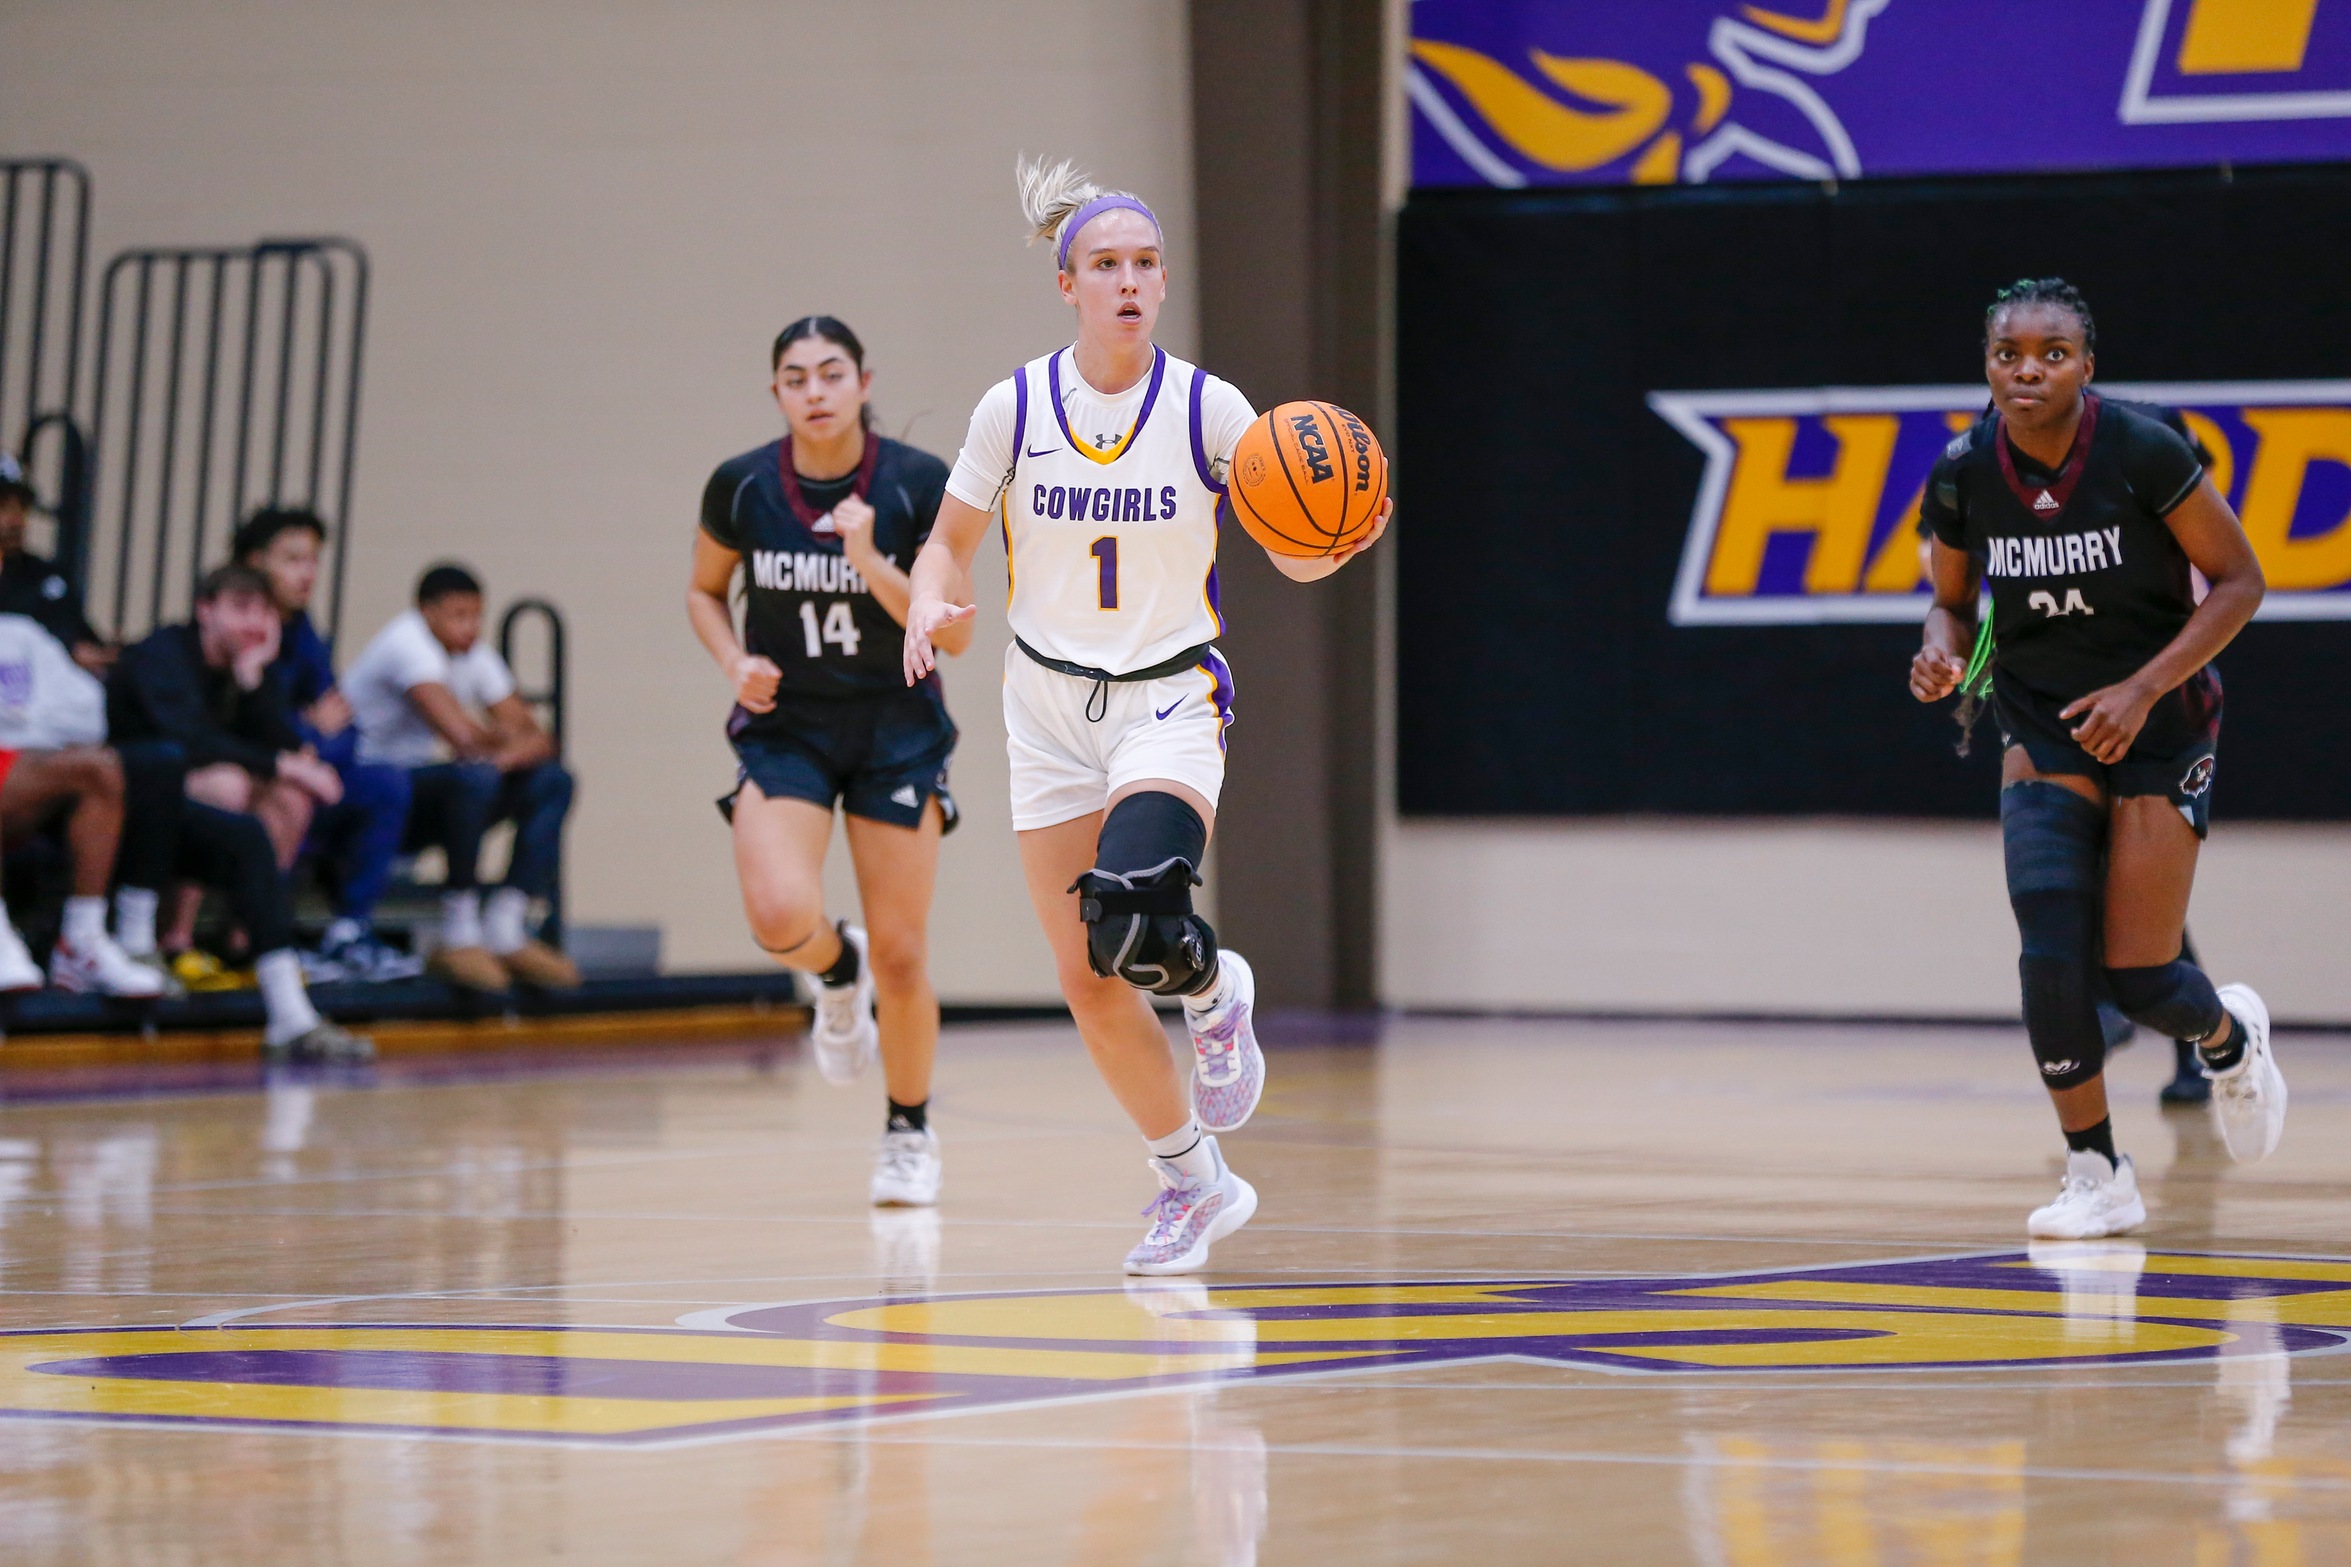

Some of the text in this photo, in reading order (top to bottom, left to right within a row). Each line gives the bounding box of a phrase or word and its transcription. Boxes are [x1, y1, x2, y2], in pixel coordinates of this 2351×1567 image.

[1291, 415, 1334, 483] NCAA
[1330, 406, 1370, 491] Wilson
[1033, 484, 1177, 522] COWGIRLS
[752, 550, 897, 594] MCMUR
[1089, 535, 1120, 612] 1
[1987, 525, 2123, 577] MCMURRY
[800, 600, 861, 658] 14
